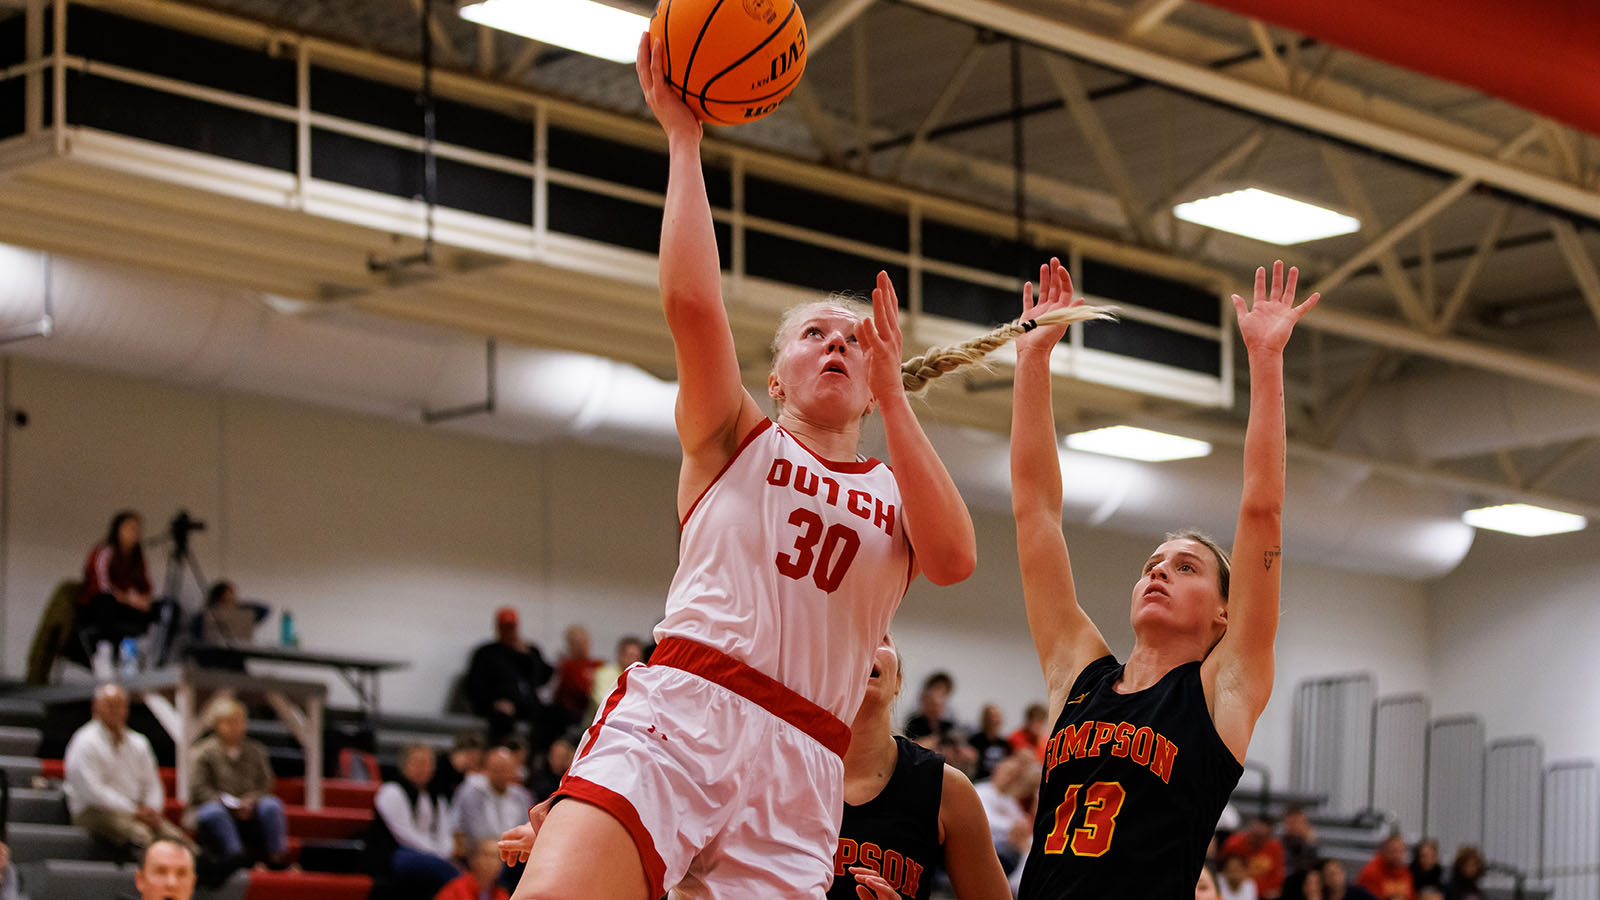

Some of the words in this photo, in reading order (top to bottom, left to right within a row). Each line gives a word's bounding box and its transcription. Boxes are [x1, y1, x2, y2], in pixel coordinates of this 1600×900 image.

[771, 28, 805, 81] EVO
[766, 458, 895, 537] DUTCH
[775, 507, 861, 595] 30
[1045, 781, 1126, 857] 13
[834, 837, 924, 899] PSON
